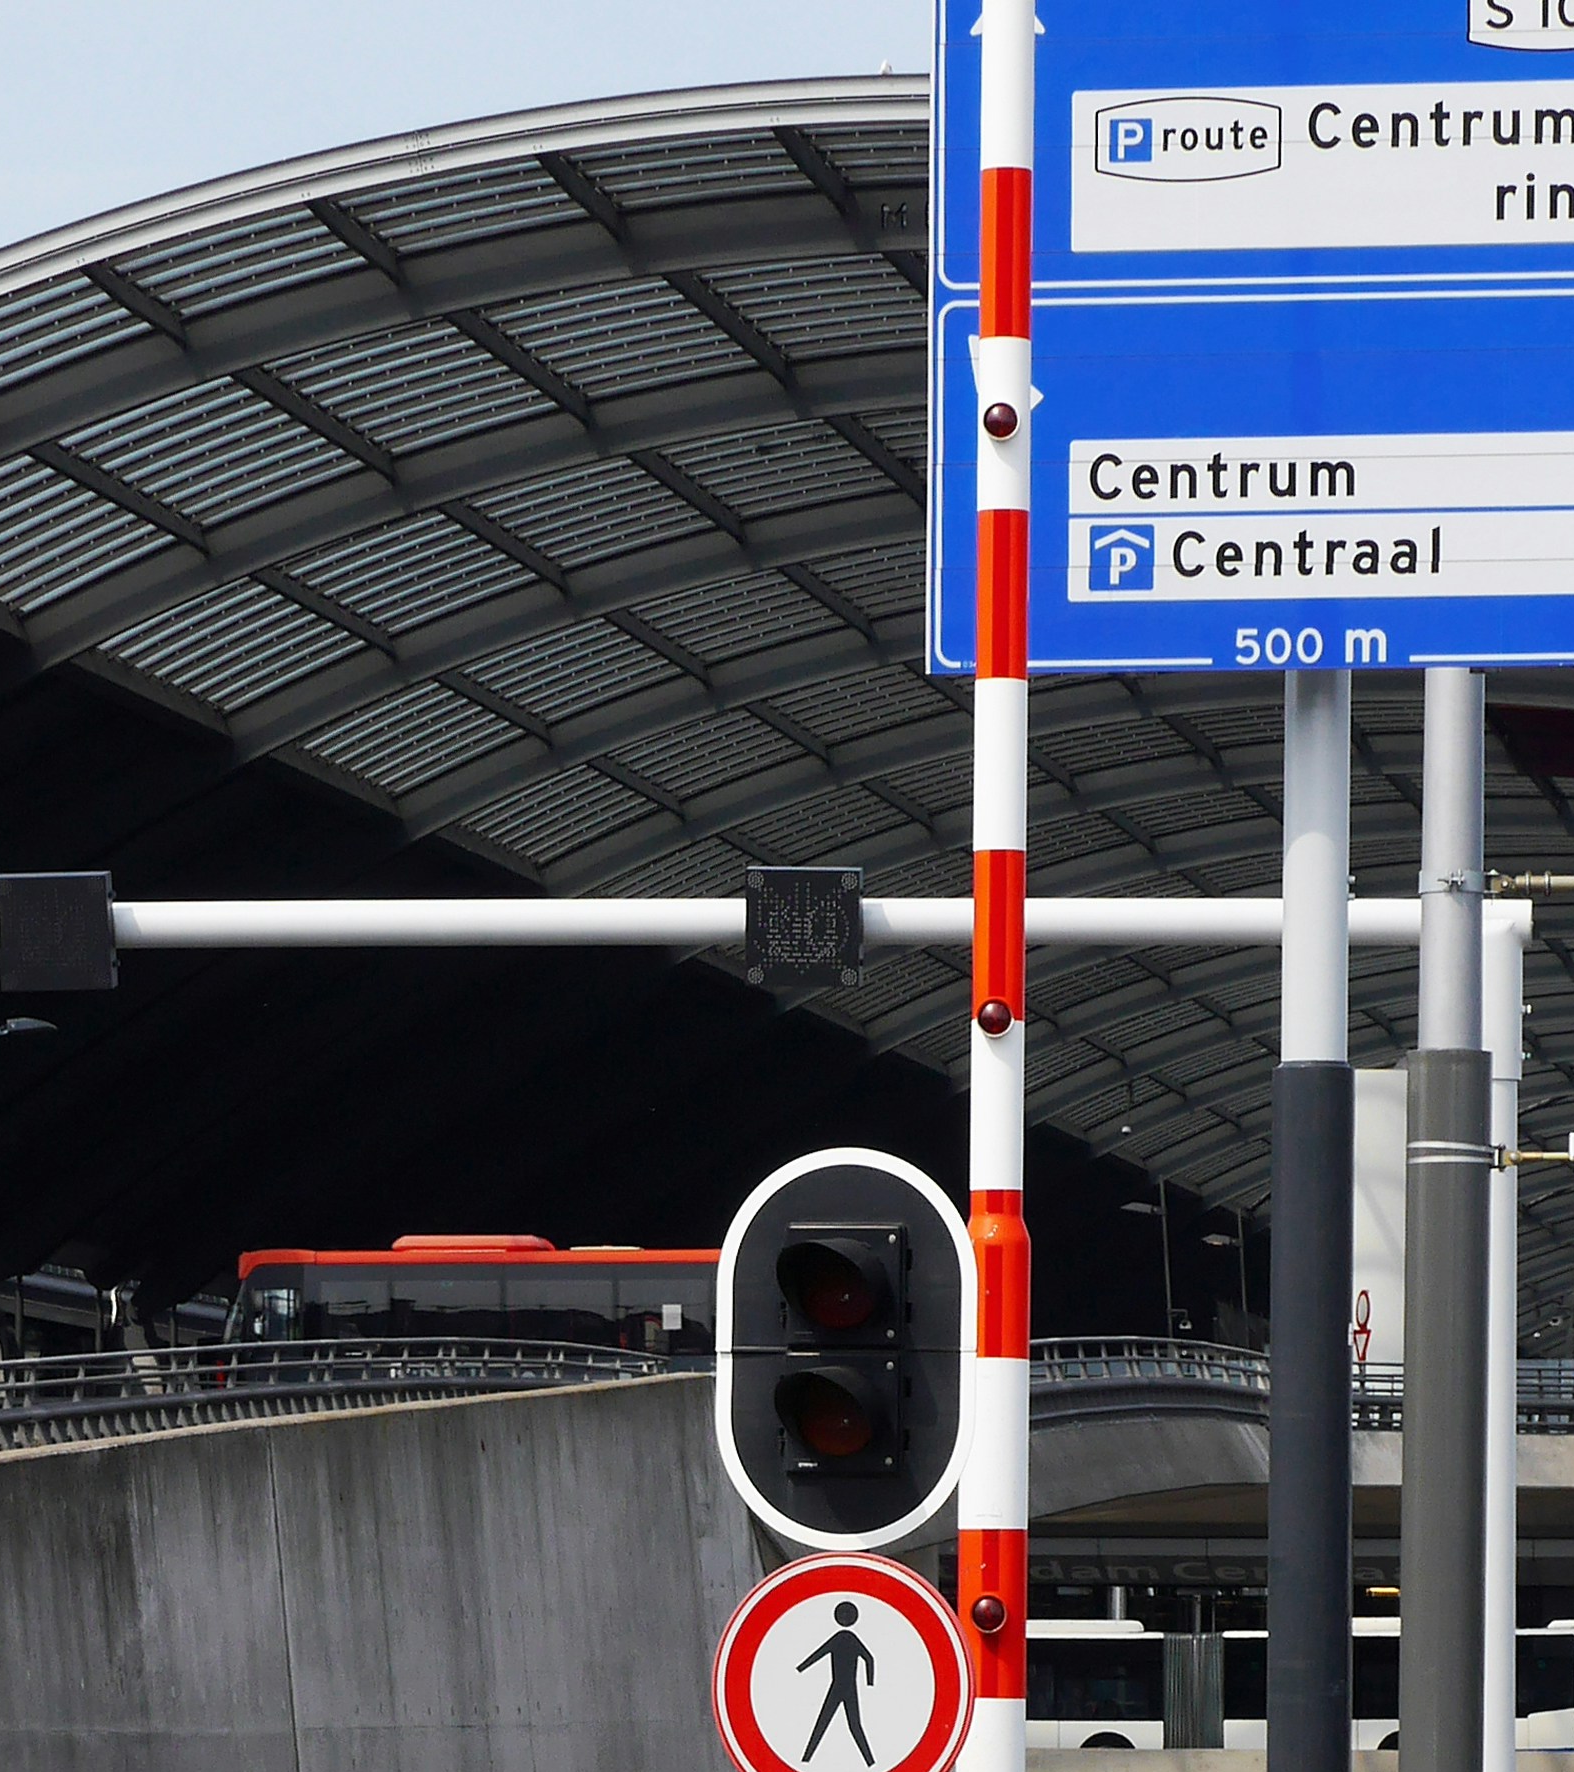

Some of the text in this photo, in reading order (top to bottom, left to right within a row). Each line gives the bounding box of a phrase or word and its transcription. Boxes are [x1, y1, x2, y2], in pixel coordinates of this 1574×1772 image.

[1486, 0, 1514, 29] S
[1161, 119, 1268, 152] route
[1089, 452, 1356, 500] Centrum
[1172, 525, 1441, 578] Centraal
[1235, 627, 1387, 665] 500 m
